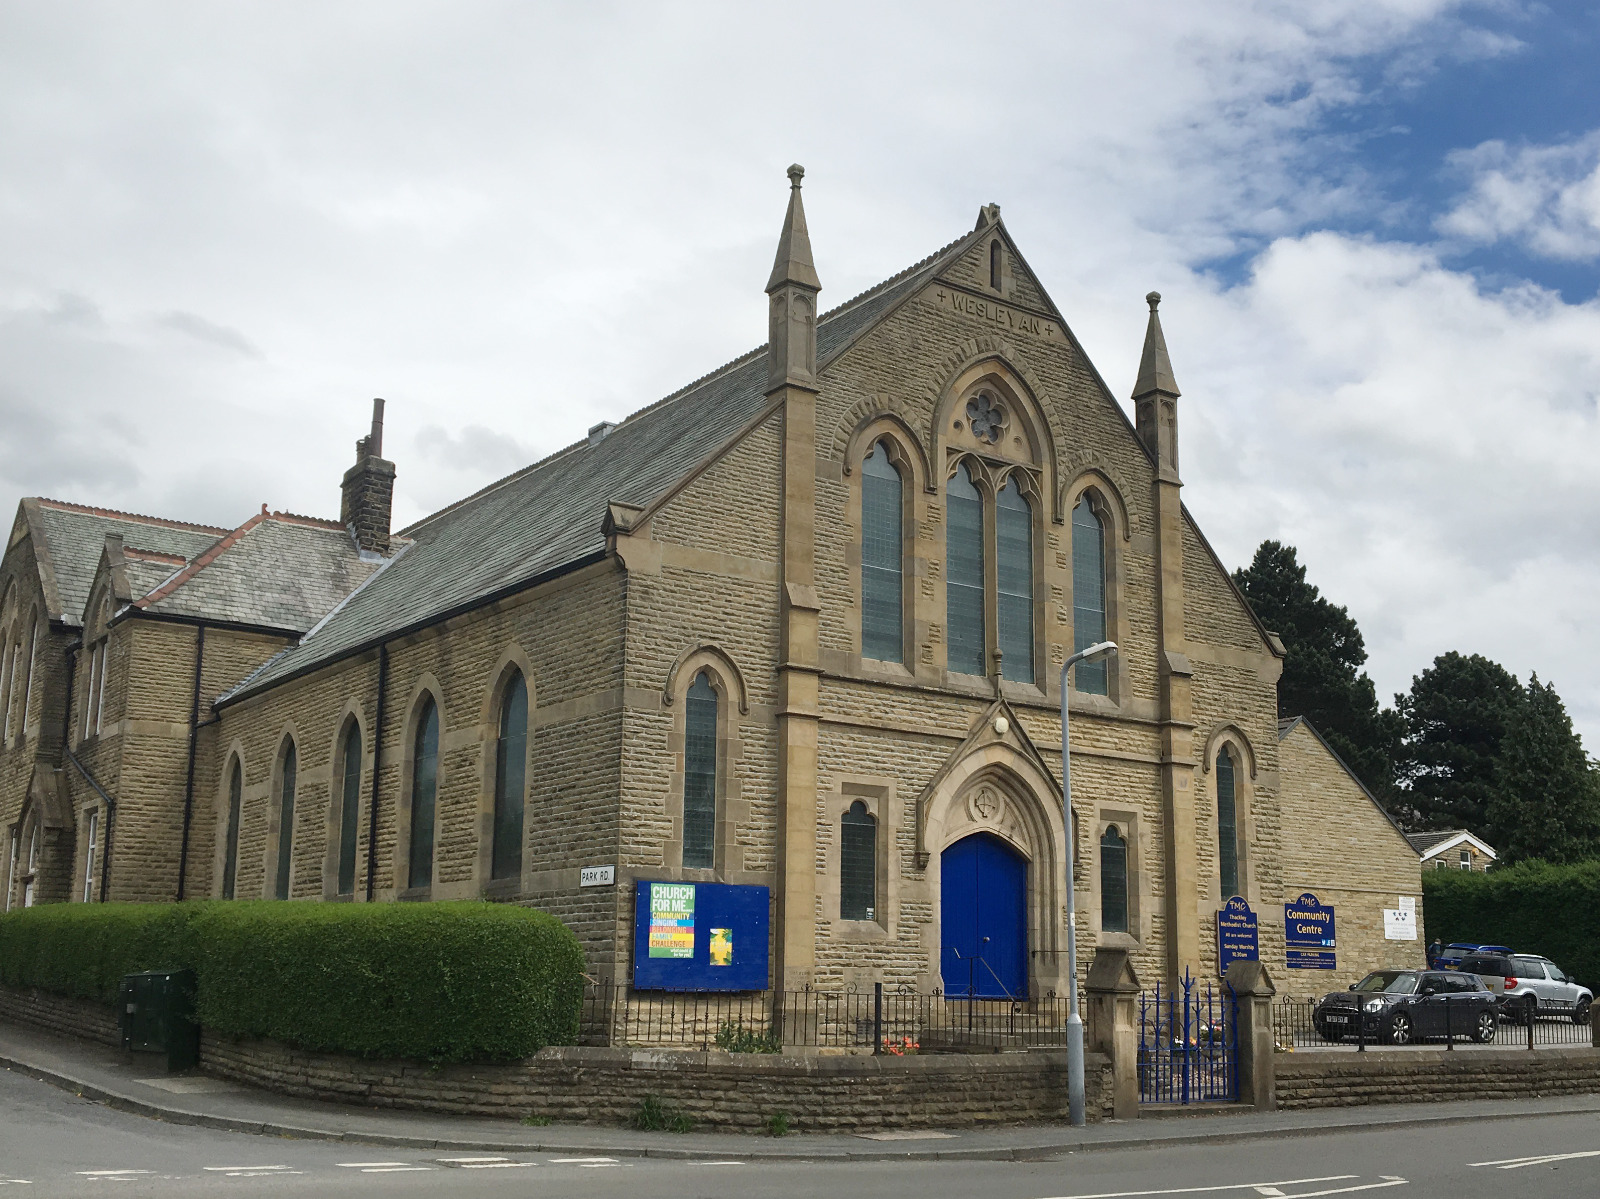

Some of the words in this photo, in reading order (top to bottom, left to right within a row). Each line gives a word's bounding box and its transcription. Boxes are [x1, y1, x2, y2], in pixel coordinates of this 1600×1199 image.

[951, 292, 1041, 336] WESLEYAN
[581, 871, 598, 883] PARK
[652, 886, 694, 900] CHURCH
[652, 899, 671, 912] FOR
[1229, 900, 1246, 911] TMC
[1300, 896, 1316, 907] TMC
[652, 912, 690, 920] COMMUNITY
[1286, 908, 1330, 924] Community
[652, 919, 678, 927] SINGING
[652, 926, 687, 934] BELONGING
[1296, 923, 1323, 935] Centre
[651, 940, 686, 948] CHALLENGE
